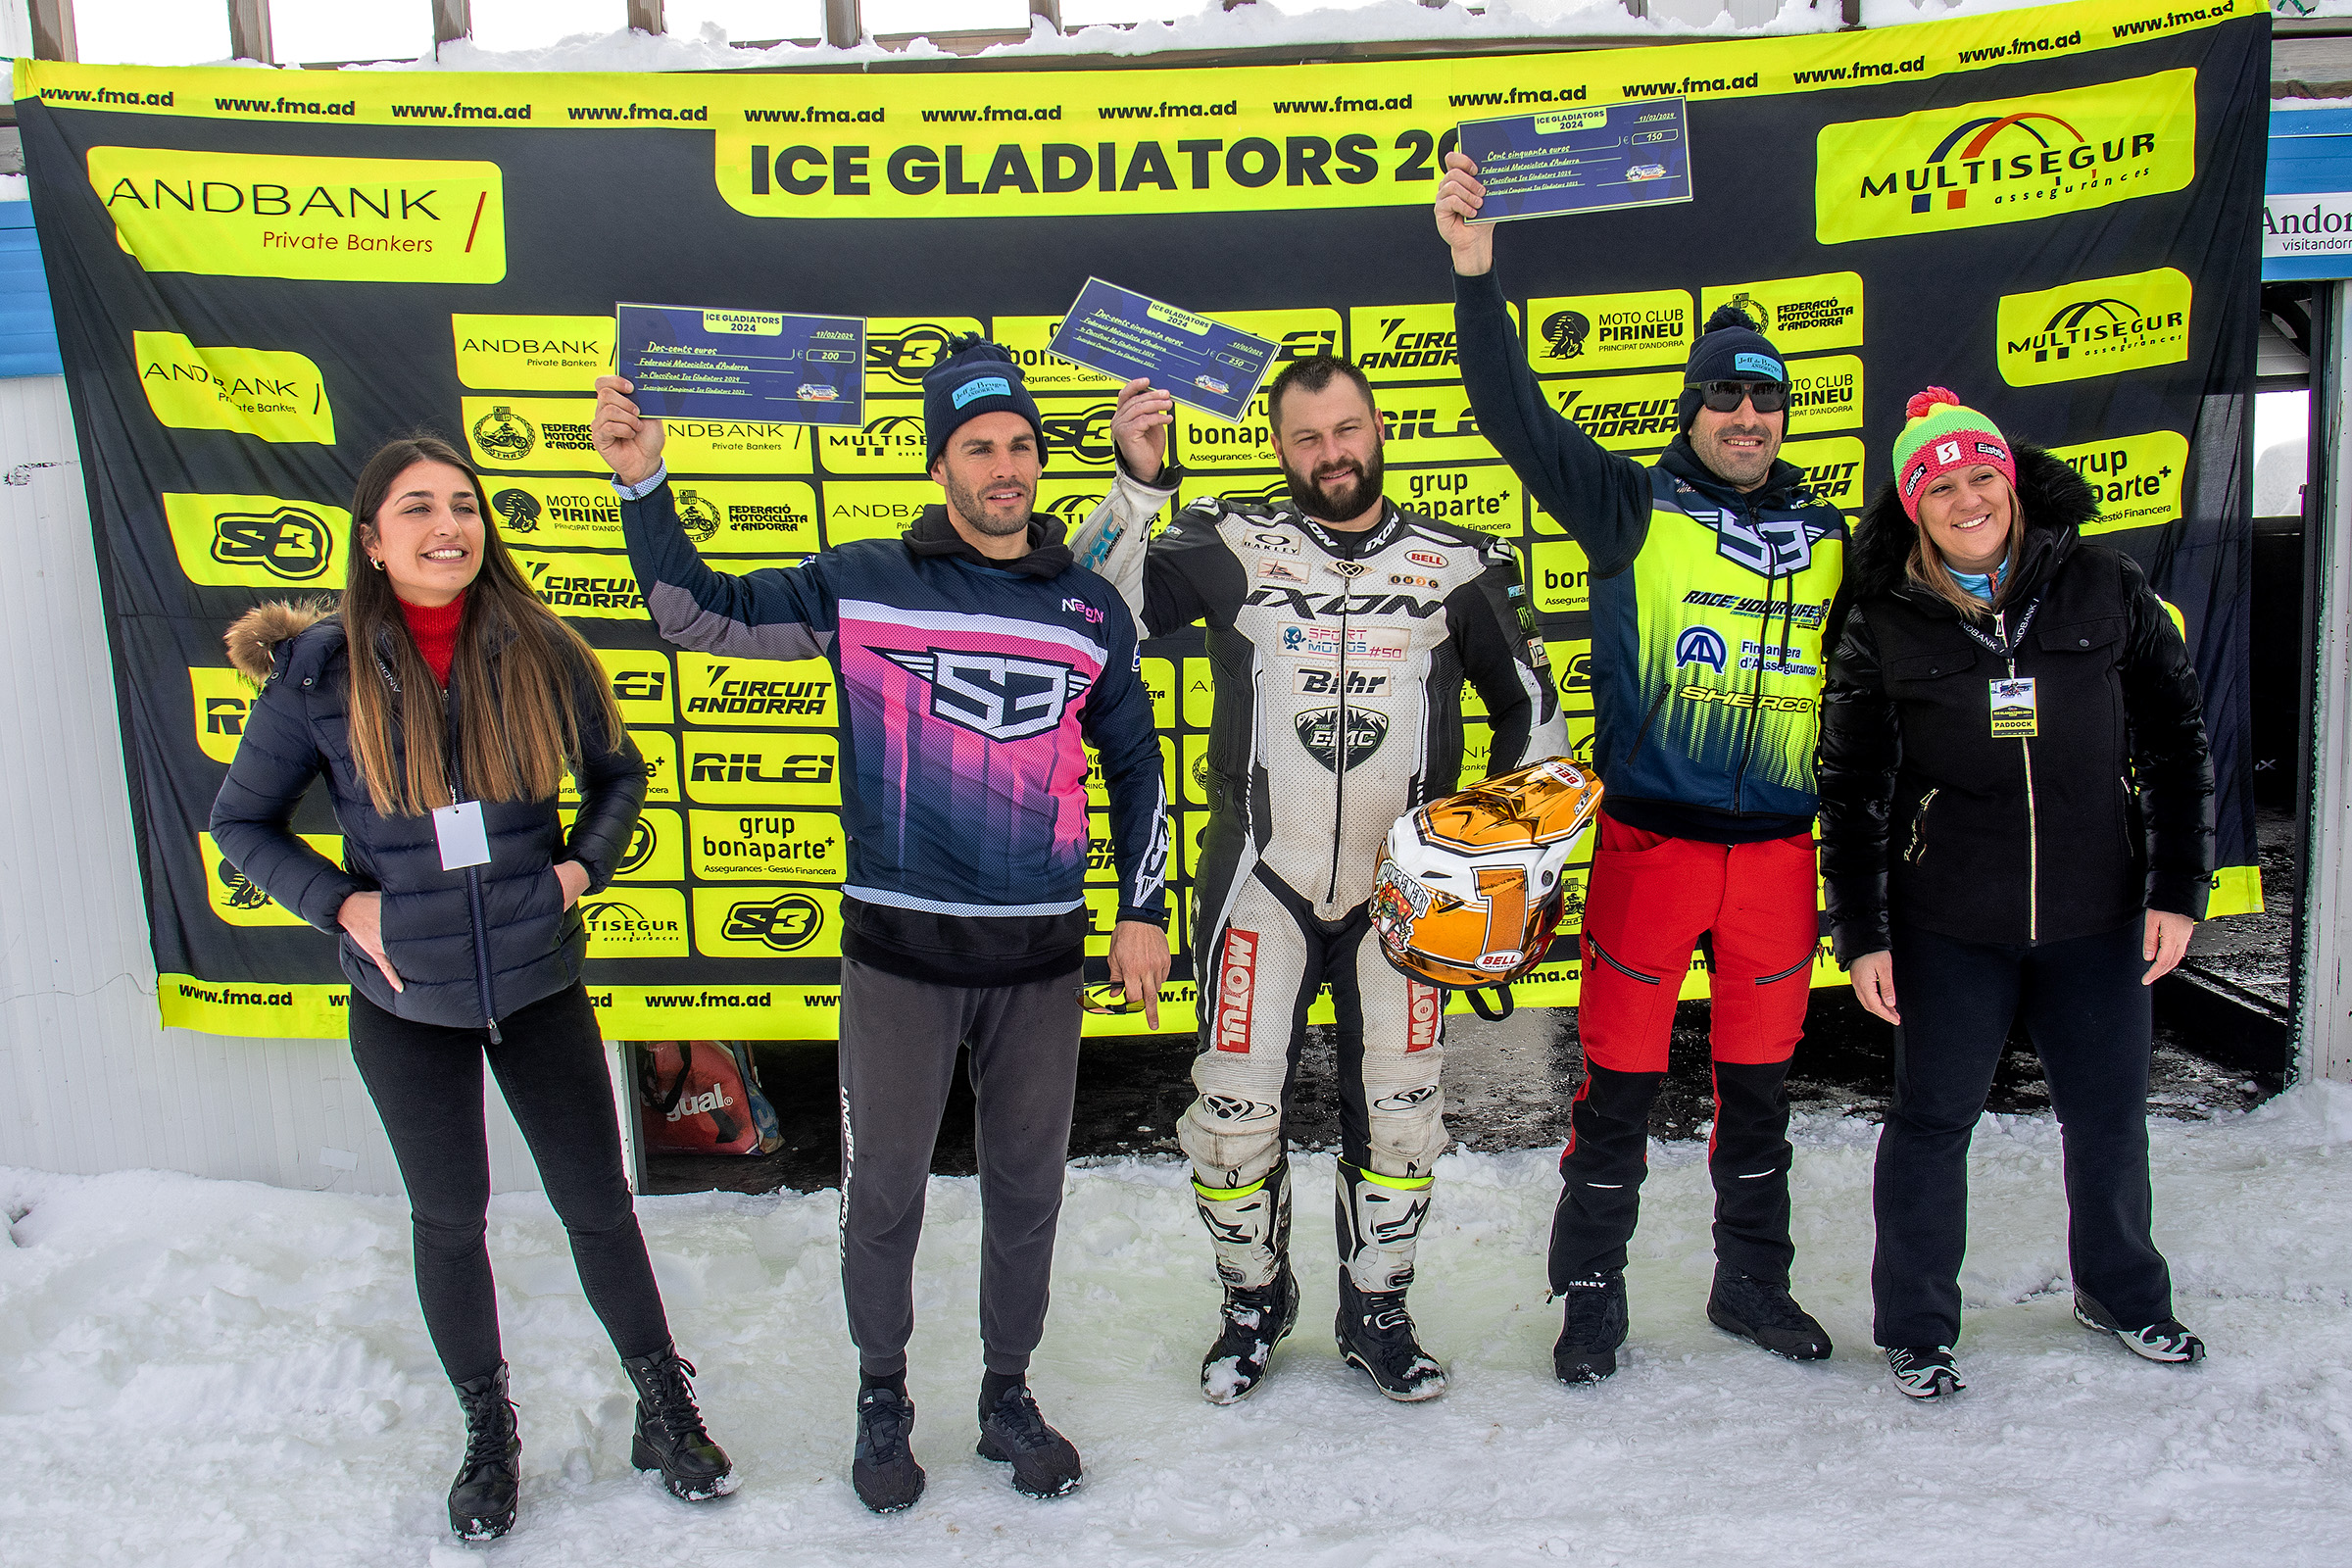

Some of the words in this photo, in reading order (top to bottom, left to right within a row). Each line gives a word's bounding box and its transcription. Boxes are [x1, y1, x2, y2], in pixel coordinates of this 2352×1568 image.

[2112, 1, 2234, 39] www.fma.ad
[1958, 31, 2082, 64] www.fma.ad
[1792, 56, 1925, 85] www.fma.ad
[1622, 74, 1759, 98] www.fma.ad
[40, 86, 174, 108] www.fma.ad
[1273, 94, 1413, 115] www.fma.ad
[1448, 85, 1588, 107] www.fma.ad
[215, 95, 356, 117] www.fma.ad
[391, 102, 532, 122] www.fma.ad
[567, 104, 709, 122] www.fma.ad
[921, 105, 1062, 123] www.fma.ad
[1098, 101, 1238, 120] www.fma.ad
[744, 107, 885, 123] www.fma.ad
[1536, 116, 1551, 125] ICE
[1551, 110, 1605, 123] GLADIATORS
[1559, 121, 1584, 130] 2024
[1646, 132, 1663, 142] 150
[1487, 151, 1506, 162] Cent
[1548, 145, 1571, 154] euros
[751, 144, 871, 196] ICE
[886, 133, 1379, 196] GLADIATORS
[1860, 132, 2156, 199] MULTISEGUR
[1994, 166, 2150, 205] assegurances
[107, 177, 442, 221] ANDBANK
[263, 230, 339, 252] Private
[347, 233, 434, 254] Bankers
[1777, 296, 1838, 314] FEDERACIÓ
[1777, 305, 1854, 321] MOTOCICLISTA
[722, 315, 780, 324] GLADIATORS
[1166, 316, 1189, 328] 2024
[1598, 311, 1642, 325] MOTO
[1645, 308, 1684, 323] CLUB
[1778, 317, 1843, 332] d'ANDORRA
[730, 322, 757, 332] 2024
[1598, 322, 1684, 342] PIRINEU
[2007, 312, 2183, 355] MULTISEGUR
[463, 338, 600, 355] ANDBANK
[647, 341, 692, 354] Dos-cents
[694, 347, 718, 356] euros
[1598, 343, 1638, 352] PRINCIPAT
[1639, 340, 1685, 350] D'ANDORRA
[2084, 335, 2182, 356] assegurances
[527, 359, 559, 368] Private
[561, 359, 598, 368] Bankers
[821, 352, 840, 361] 200
[1228, 357, 1245, 368] 250
[1815, 373, 1853, 387] CLUB
[1809, 405, 1854, 416] D'ANDORRA
[664, 424, 785, 438] NDBANK
[712, 442, 747, 452] Private
[749, 442, 782, 451] Bankers
[1189, 452, 1251, 463] Assegurances
[1409, 472, 1468, 499] grup
[546, 495, 591, 508] MOTO
[728, 504, 792, 514] FEDERACIÓ
[729, 514, 808, 524] MOTOCICLISTA
[2124, 504, 2172, 518] Financera
[729, 521, 800, 532] d'ANDORRA
[217, 511, 326, 575] S3
[1411, 553, 1444, 565] BELL
[1682, 589, 1738, 608] RACE
[1369, 646, 1402, 659] #50
[720, 680, 832, 697] CIRCUIT
[687, 698, 827, 715] ANDORRA
[1680, 685, 1813, 712] SHERCO
[691, 753, 835, 783] RILEI
[740, 816, 796, 839] grup
[704, 864, 763, 874] Assegurances
[768, 864, 795, 874] Gestió
[795, 866, 837, 875] Financera
[727, 896, 819, 948] S3
[1482, 955, 1517, 965] BELL
[1220, 931, 1254, 1048] MOTUL
[644, 991, 772, 1008] www.fma.ad
[841, 1086, 855, 1162] UNDER
